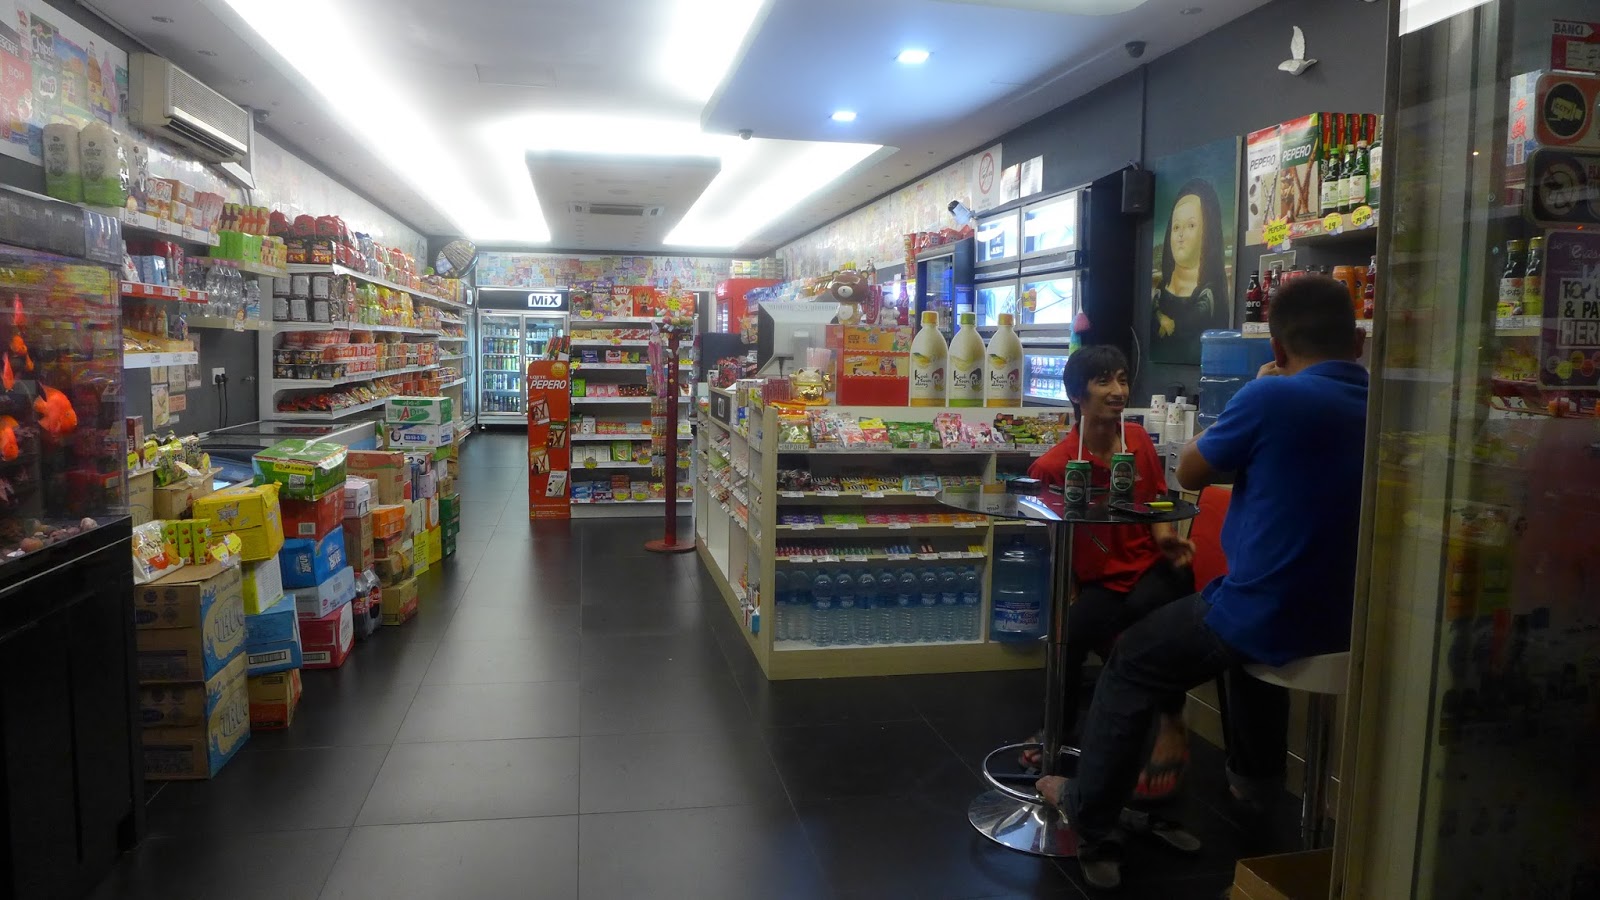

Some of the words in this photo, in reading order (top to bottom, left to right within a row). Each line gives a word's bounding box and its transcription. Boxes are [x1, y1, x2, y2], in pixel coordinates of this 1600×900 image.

[1553, 22, 1584, 35] BANCI
[1282, 143, 1312, 163] PEPERO
[1249, 154, 1276, 172] PEPERO
[531, 295, 558, 306] MiX
[1564, 300, 1575, 319] &
[1581, 300, 1600, 319] PA
[1561, 320, 1600, 346] HER
[530, 379, 567, 390] PEPERO
